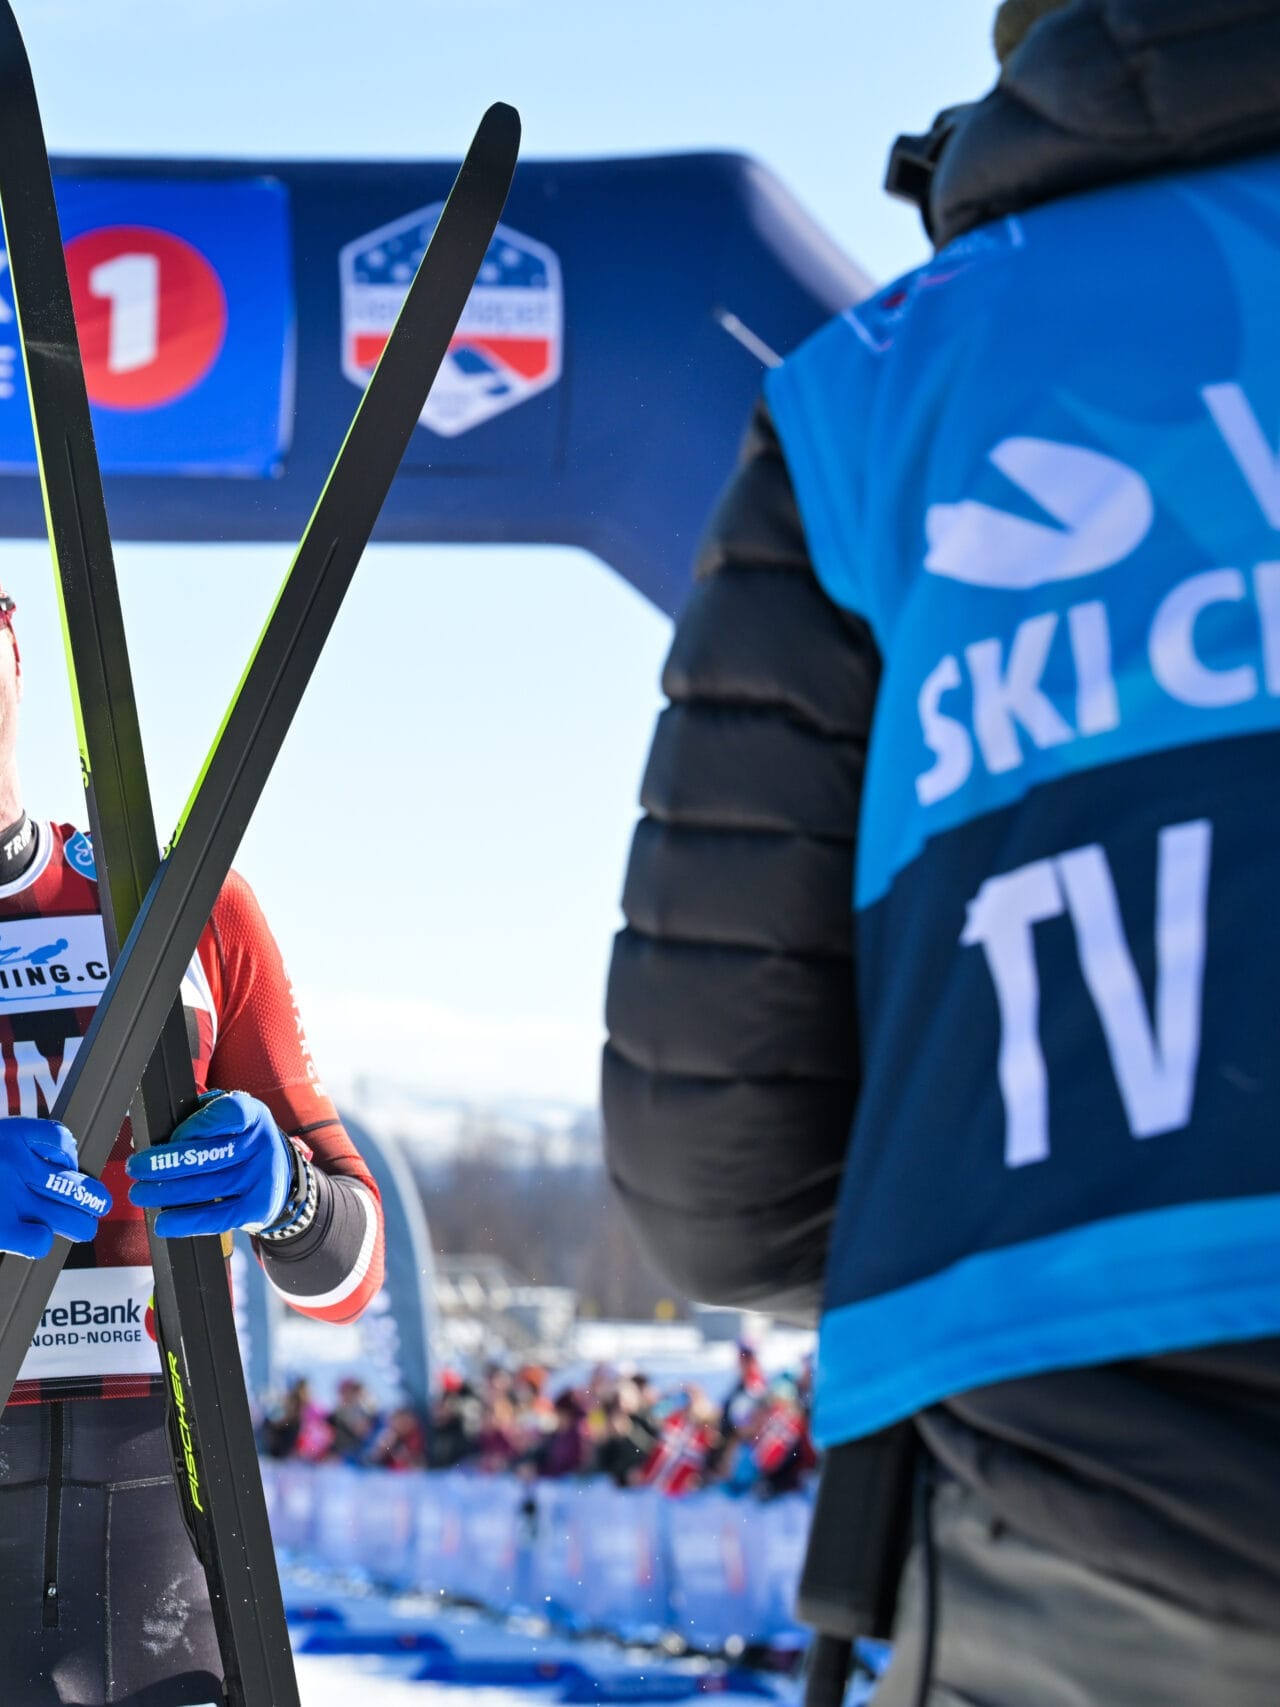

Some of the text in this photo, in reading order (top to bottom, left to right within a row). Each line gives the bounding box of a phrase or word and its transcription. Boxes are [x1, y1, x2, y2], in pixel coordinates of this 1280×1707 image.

[88, 253, 160, 374] 1
[915, 600, 1120, 806] SKI
[959, 817, 1213, 1169] TV
[31, 1330, 142, 1347] NORD-NORGE
[40, 1298, 141, 1328] reBank
[168, 1351, 204, 1513] FISCHER
